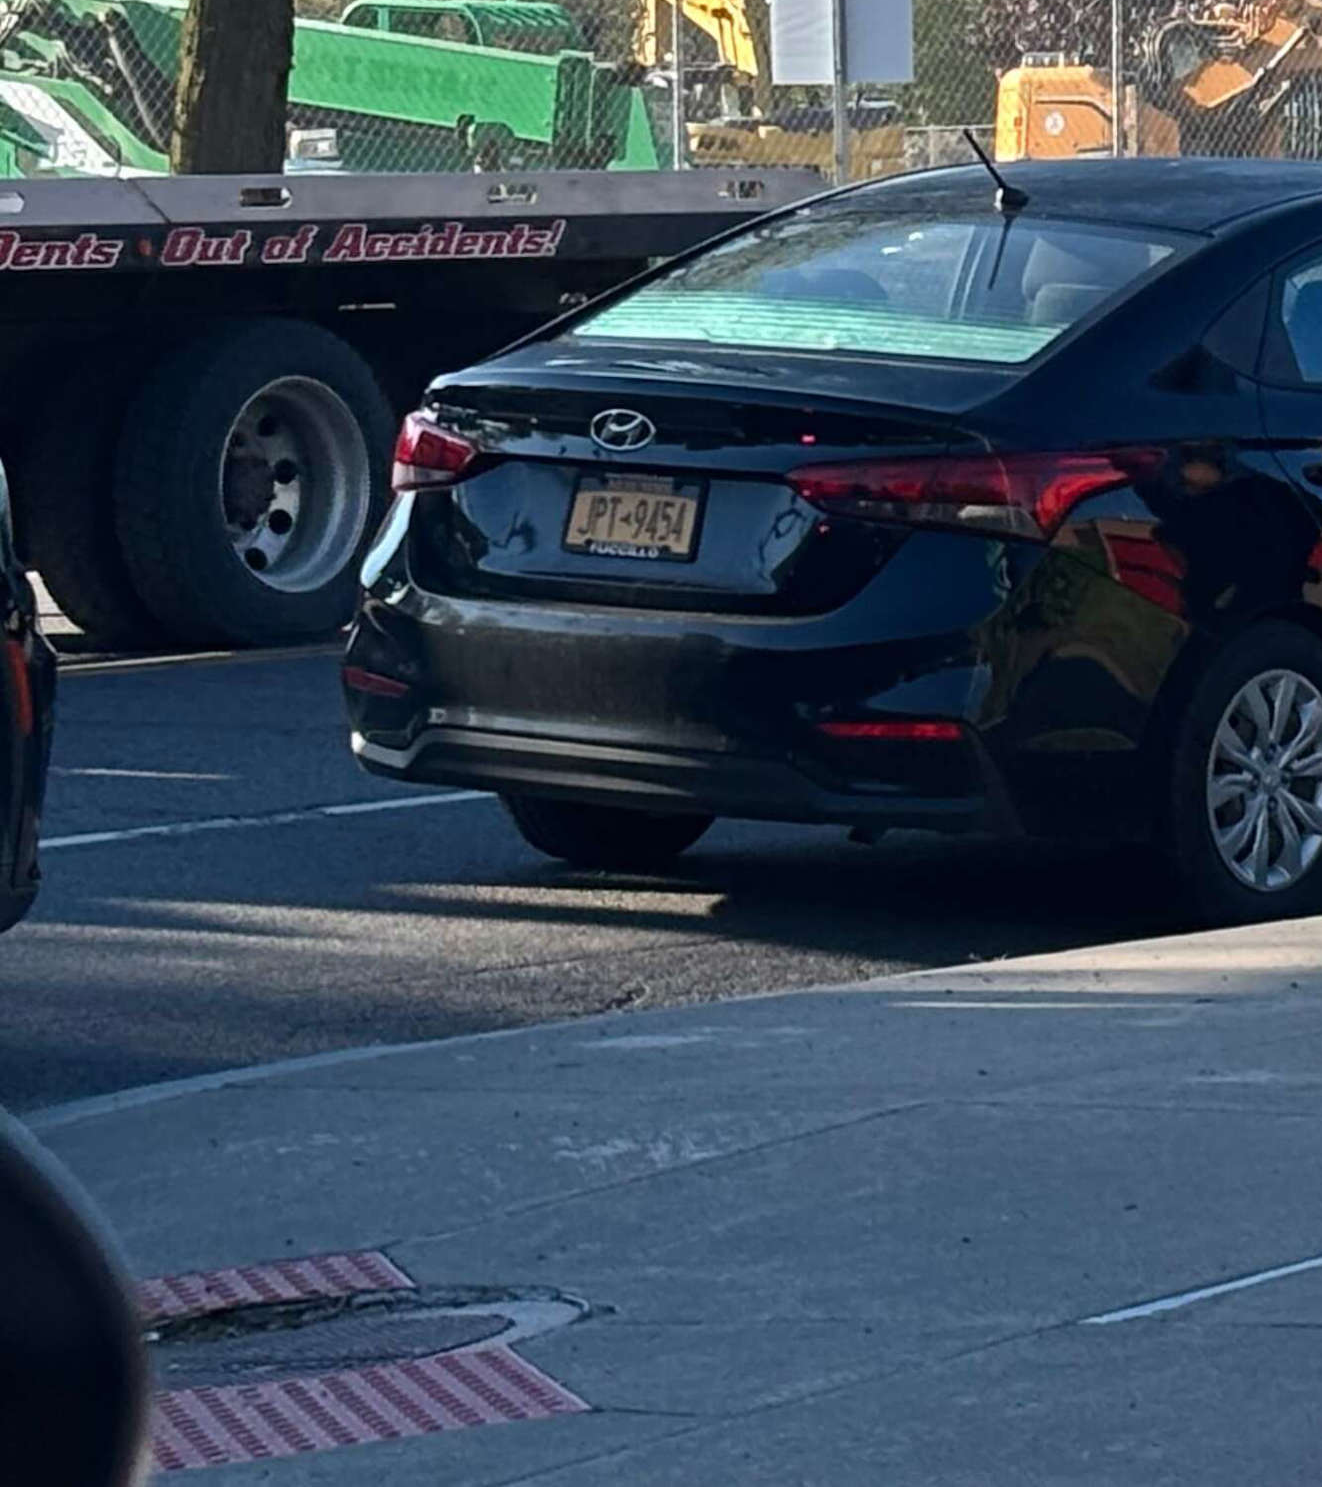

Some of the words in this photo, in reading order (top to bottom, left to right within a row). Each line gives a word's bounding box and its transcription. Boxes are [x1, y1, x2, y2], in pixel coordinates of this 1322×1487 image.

[162, 227, 251, 265] Out
[261, 225, 319, 263] of
[322, 219, 566, 261] Accidents!
